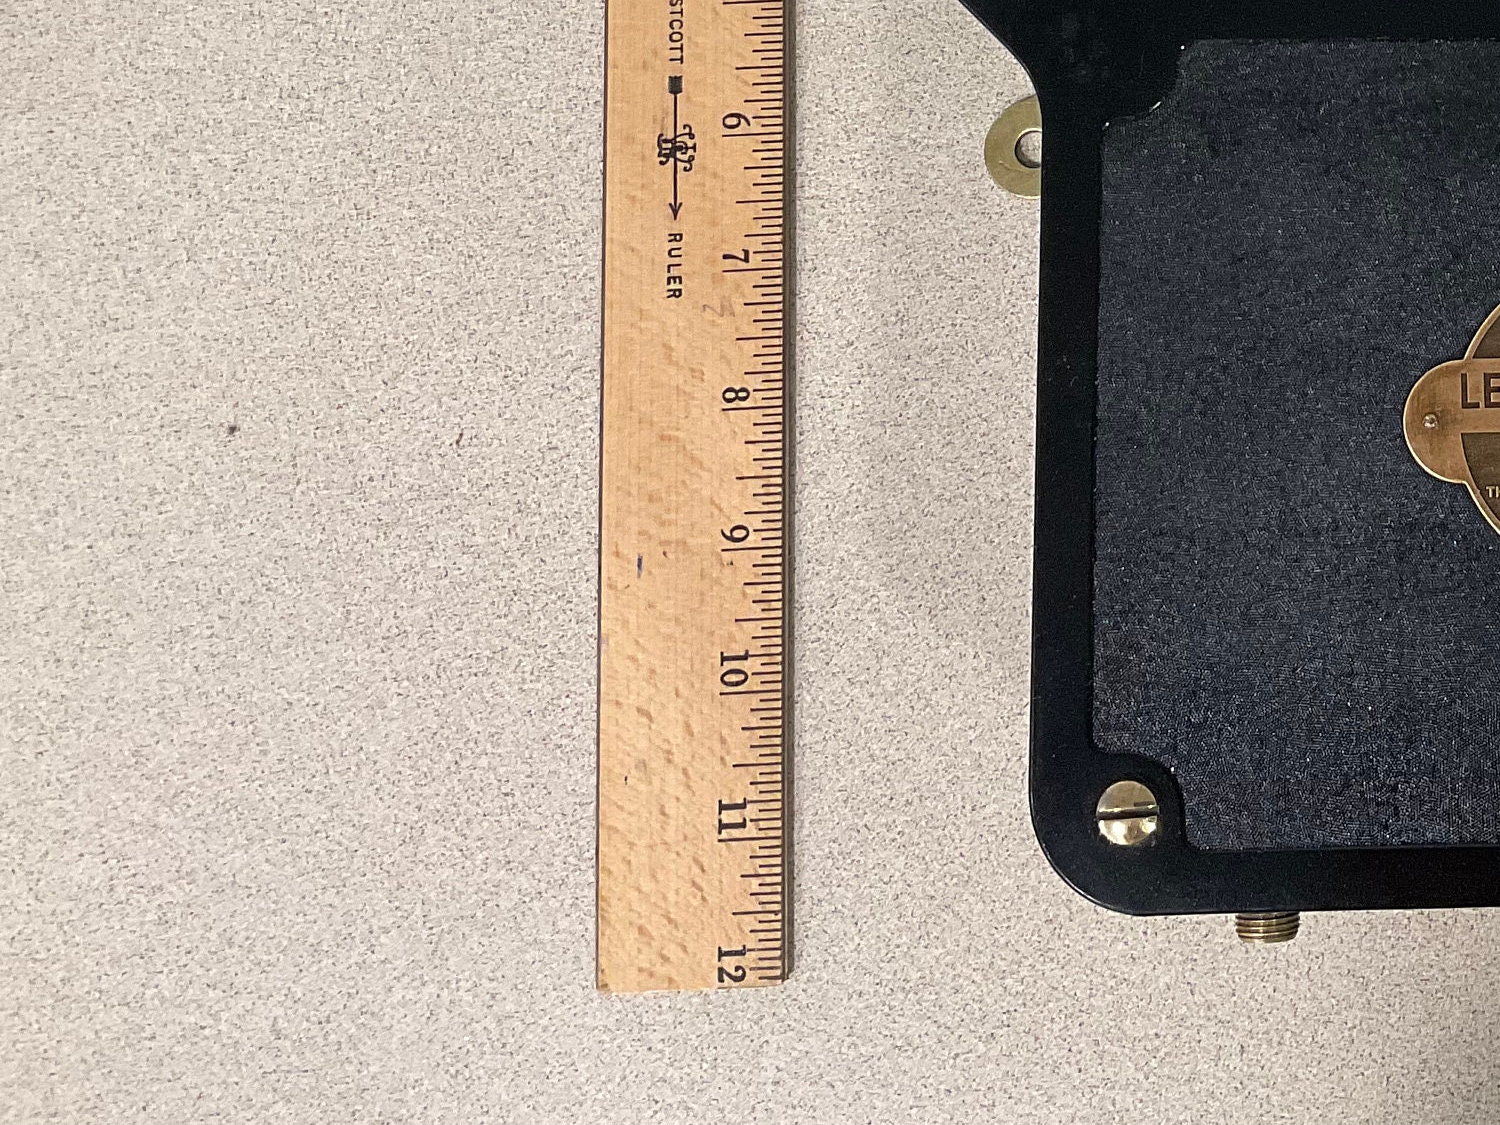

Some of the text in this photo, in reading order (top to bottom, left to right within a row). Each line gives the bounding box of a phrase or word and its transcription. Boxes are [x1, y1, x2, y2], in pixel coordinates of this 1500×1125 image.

[722, 112, 751, 130] 6
[666, 232, 683, 300] RULER
[722, 248, 750, 264] 7
[722, 386, 751, 404] 8
[721, 525, 751, 543] 9
[720, 650, 750, 687] 10
[717, 797, 747, 835] 11
[717, 944, 747, 983] 12
